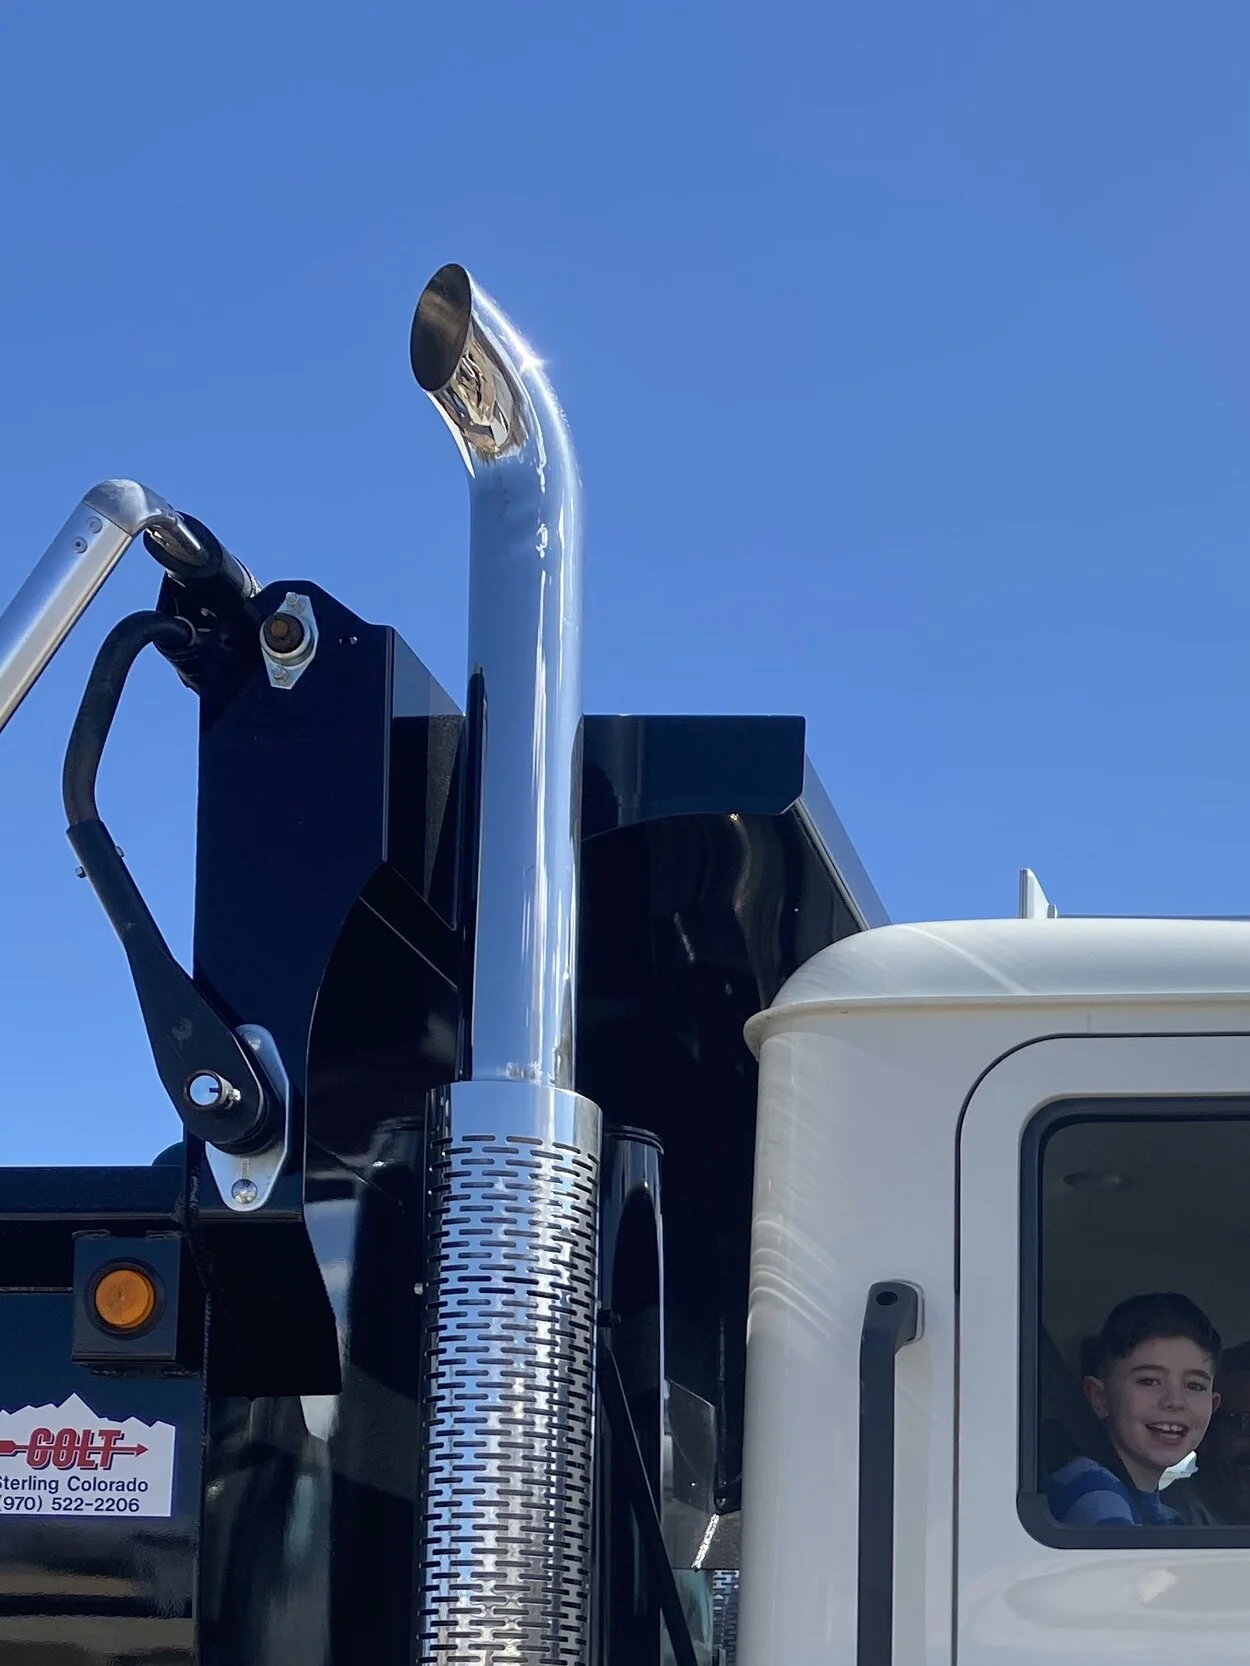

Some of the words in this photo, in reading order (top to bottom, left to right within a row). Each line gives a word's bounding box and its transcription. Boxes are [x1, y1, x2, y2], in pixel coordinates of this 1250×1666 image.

[26, 1428, 124, 1470] COLT
[67, 1475, 149, 1492] Colorado
[51, 1497, 140, 1512] 522-2206
